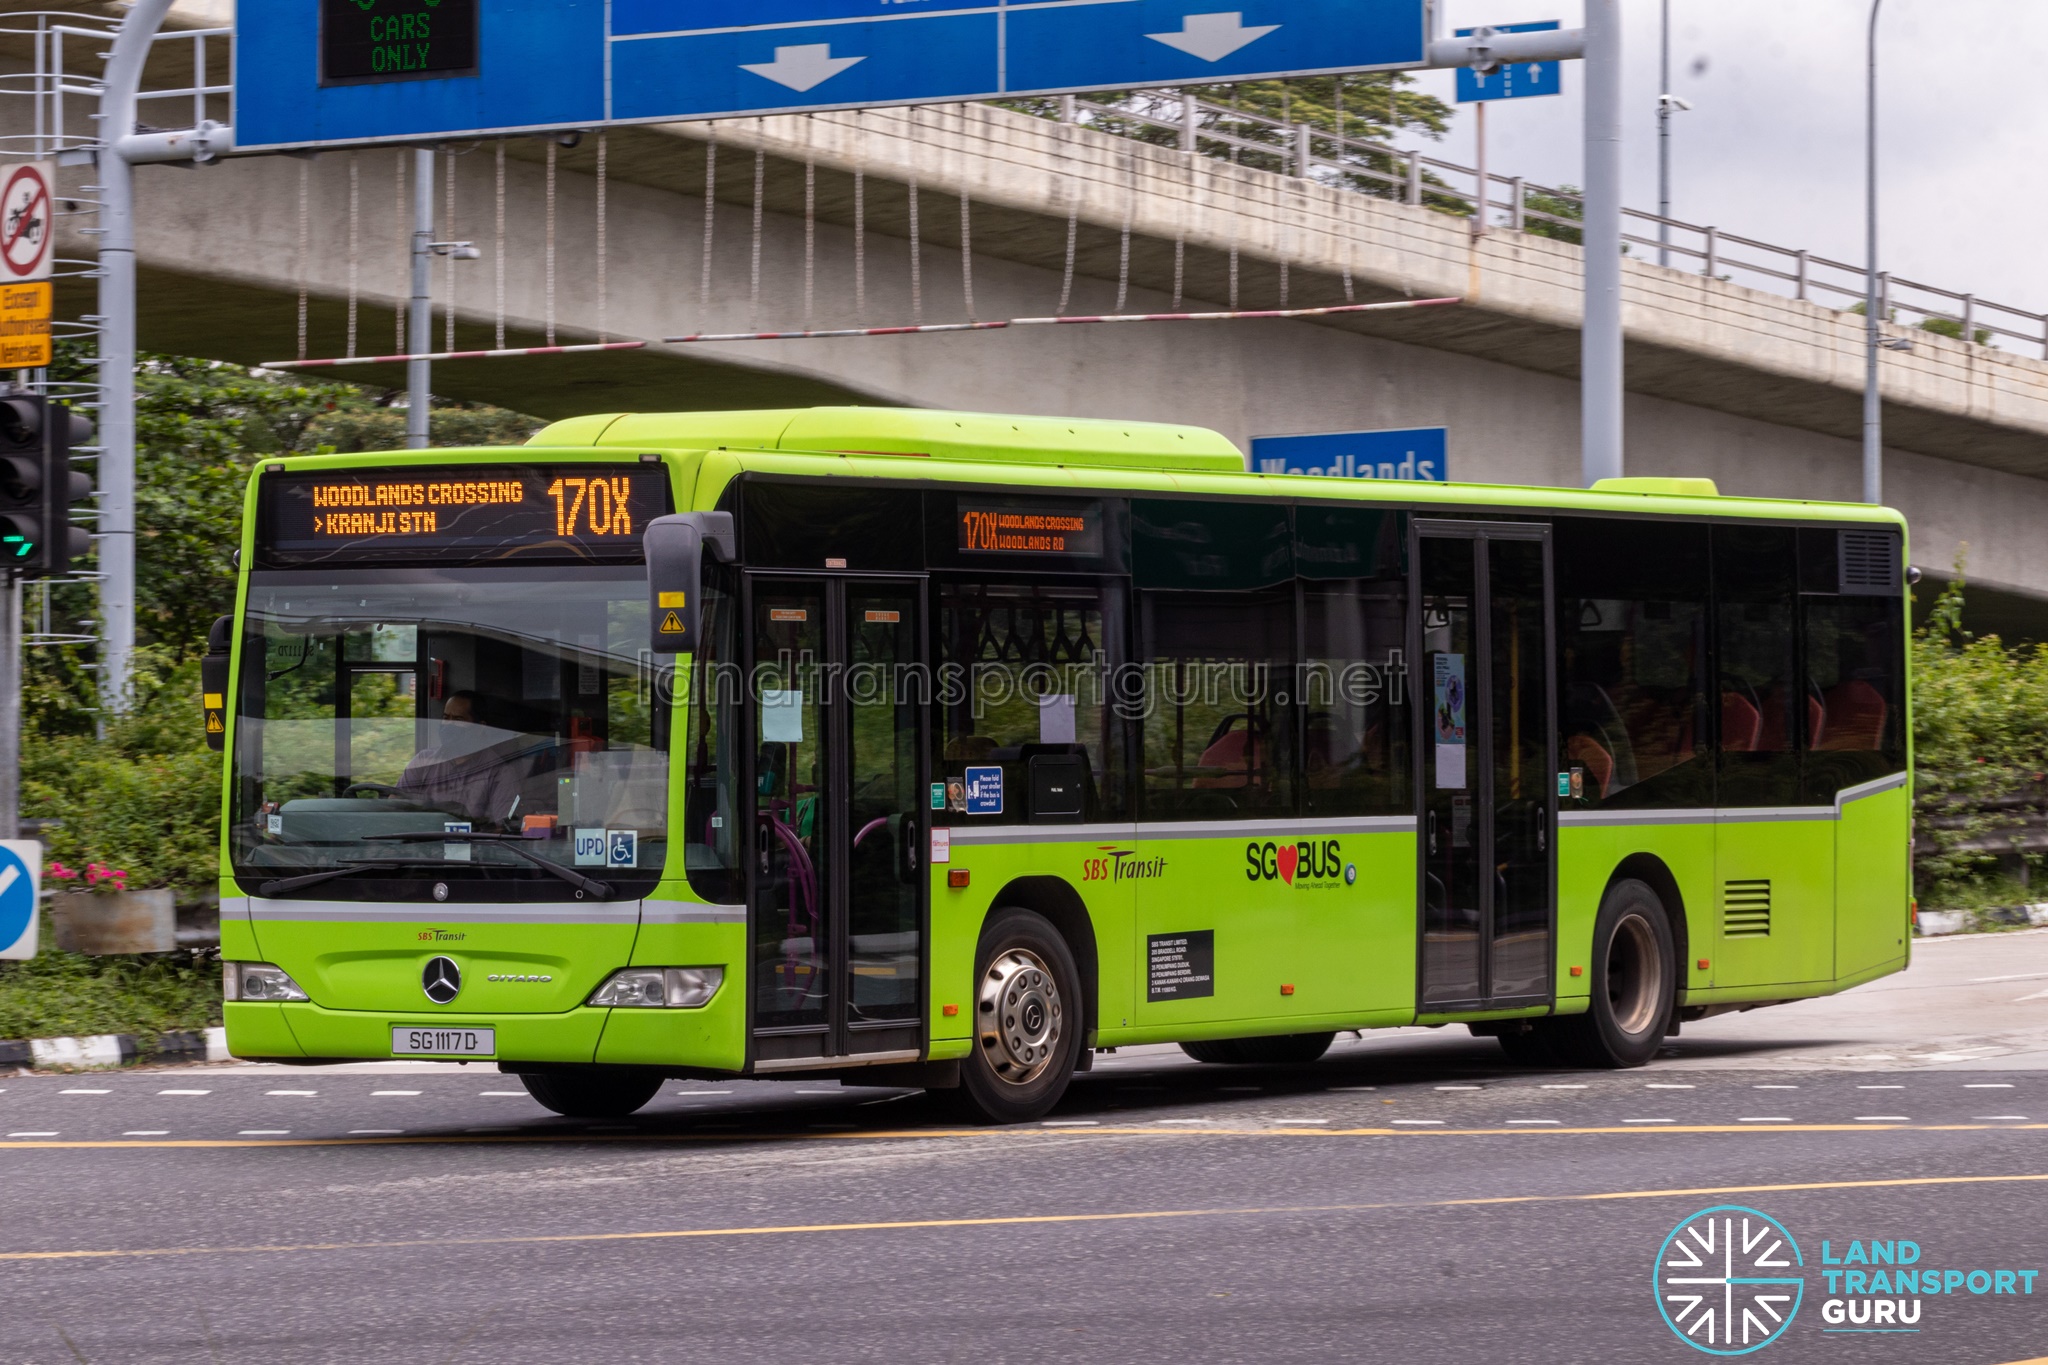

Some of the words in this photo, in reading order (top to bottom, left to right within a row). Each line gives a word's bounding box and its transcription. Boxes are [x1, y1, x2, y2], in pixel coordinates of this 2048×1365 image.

[370, 12, 430, 42] CARS
[371, 42, 430, 72] ONLY
[1260, 451, 1435, 481] Wdlands
[314, 483, 424, 507] WOODLANDS
[428, 482, 522, 504] CROSSING
[547, 477, 631, 536] 170X
[326, 512, 397, 534] KRANJI
[399, 511, 436, 533] STN
[963, 511, 998, 550] 170X
[998, 514, 1045, 530] WOODLANDS
[1045, 517, 1084, 531] CROSSING
[999, 535, 1051, 550] WOODLANDS
[1053, 537, 1064, 551] RD
[989, 782, 1000, 790] stroller
[980, 799, 996, 807] crowded
[576, 838, 604, 856] UPD
[1082, 858, 1108, 881] SBS
[1107, 851, 1168, 884] Transit
[1246, 842, 1278, 881] SG
[1296, 840, 1341, 879] BUS
[418, 932, 432, 941] SBS
[433, 929, 467, 942] Transit
[487, 974, 552, 983] CITARO
[409, 1031, 476, 1050] SG1117D
